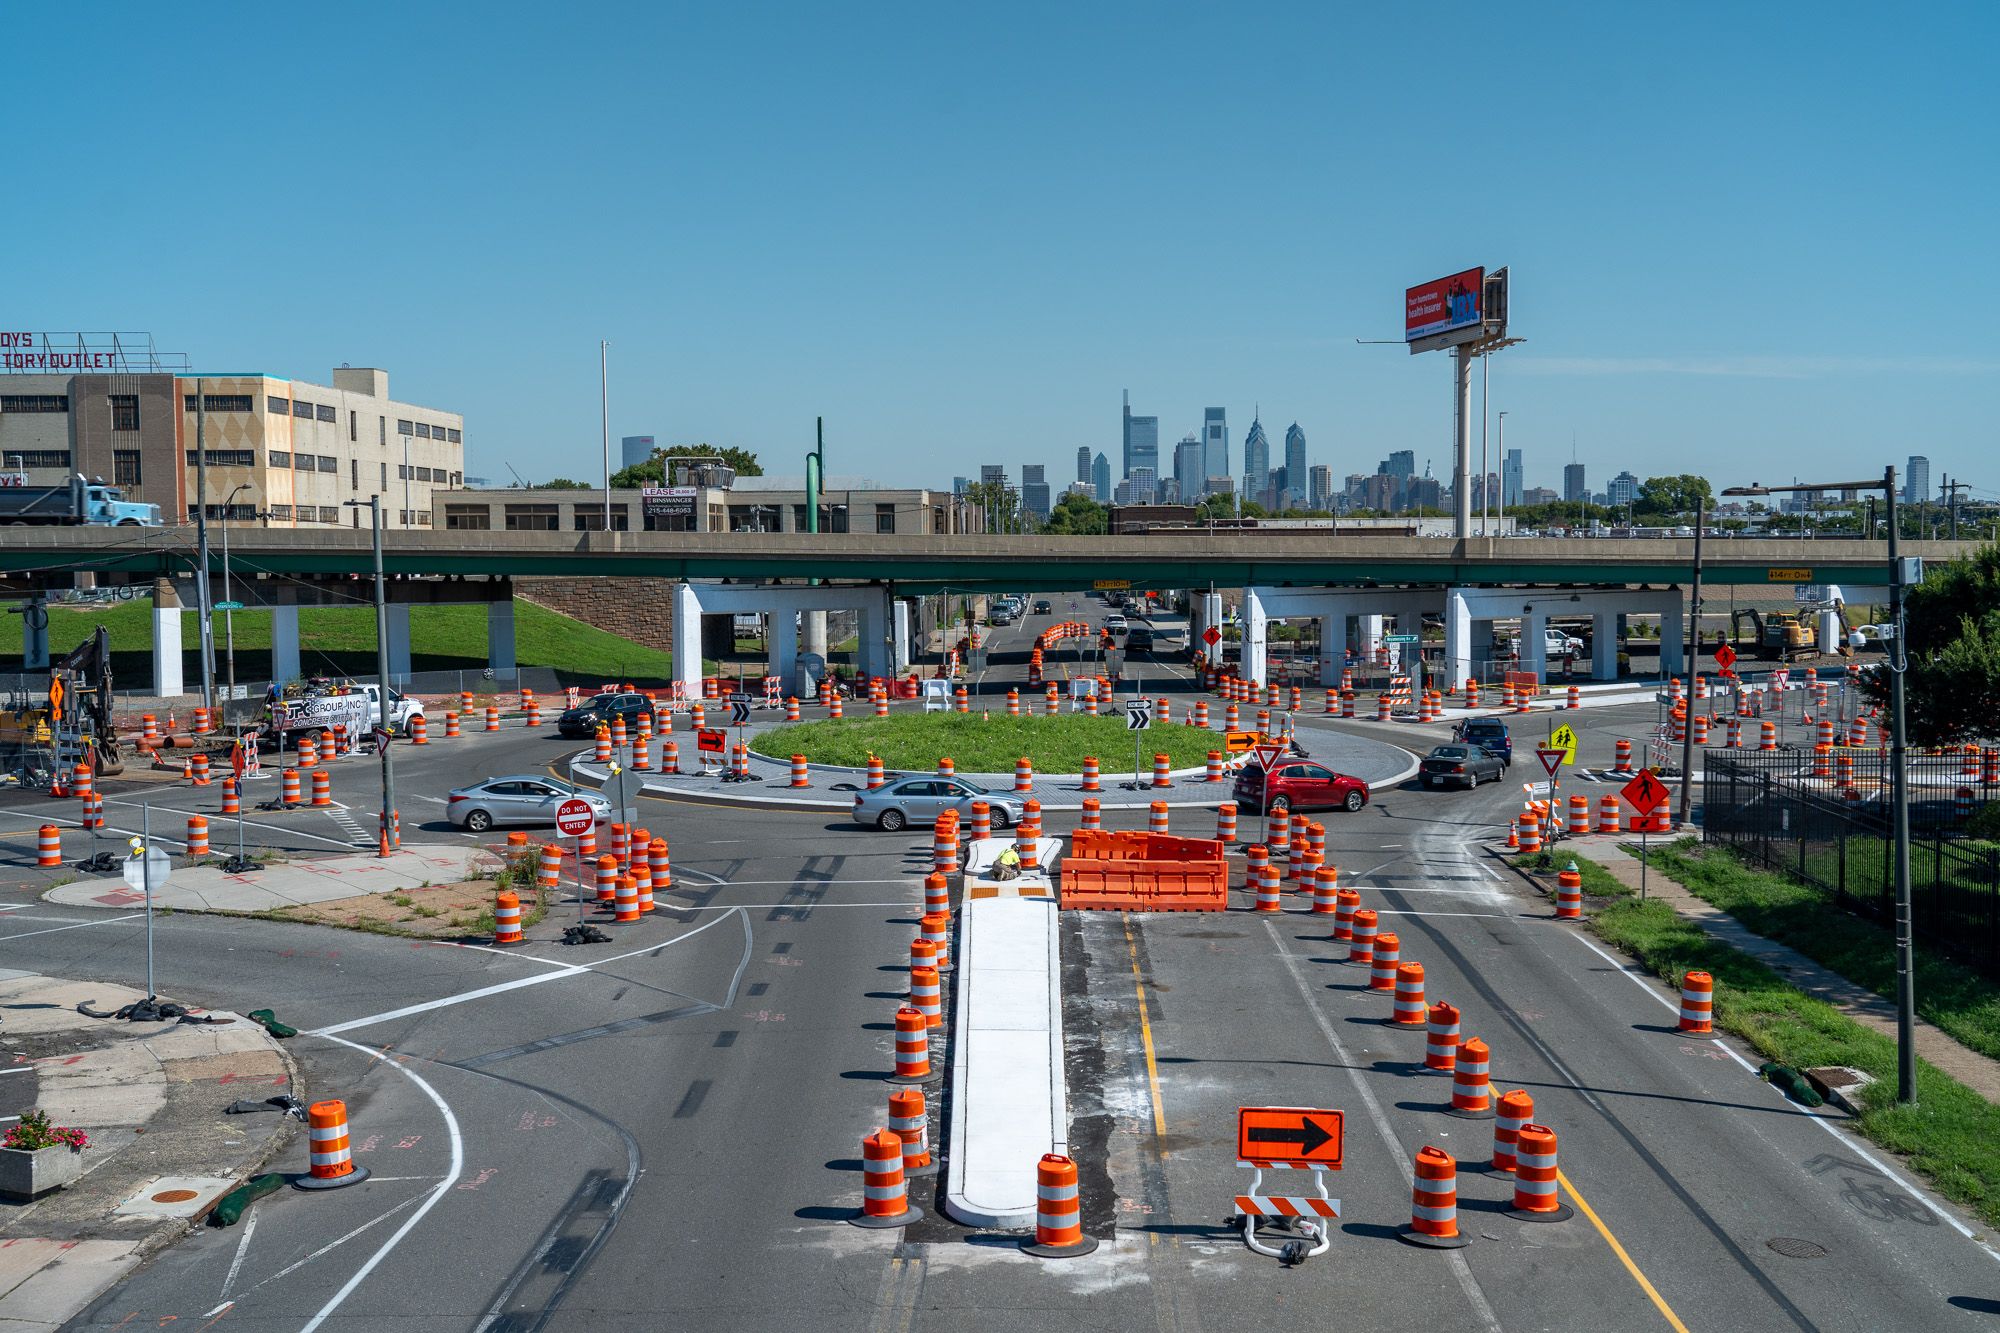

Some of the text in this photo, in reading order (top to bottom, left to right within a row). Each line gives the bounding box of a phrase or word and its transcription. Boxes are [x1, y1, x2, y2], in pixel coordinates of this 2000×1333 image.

[1408, 292, 1438, 305] Your hometown
[1408, 302, 1442, 318] health insurer
[50, 353, 115, 368] OUTLET
[644, 488, 675, 496] LEASE
[288, 699, 363, 720] JPC GROUP, INC.
[292, 715, 329, 728] CONCRETE
[561, 804, 588, 814] DO NOT
[564, 821, 586, 830] ENTER
